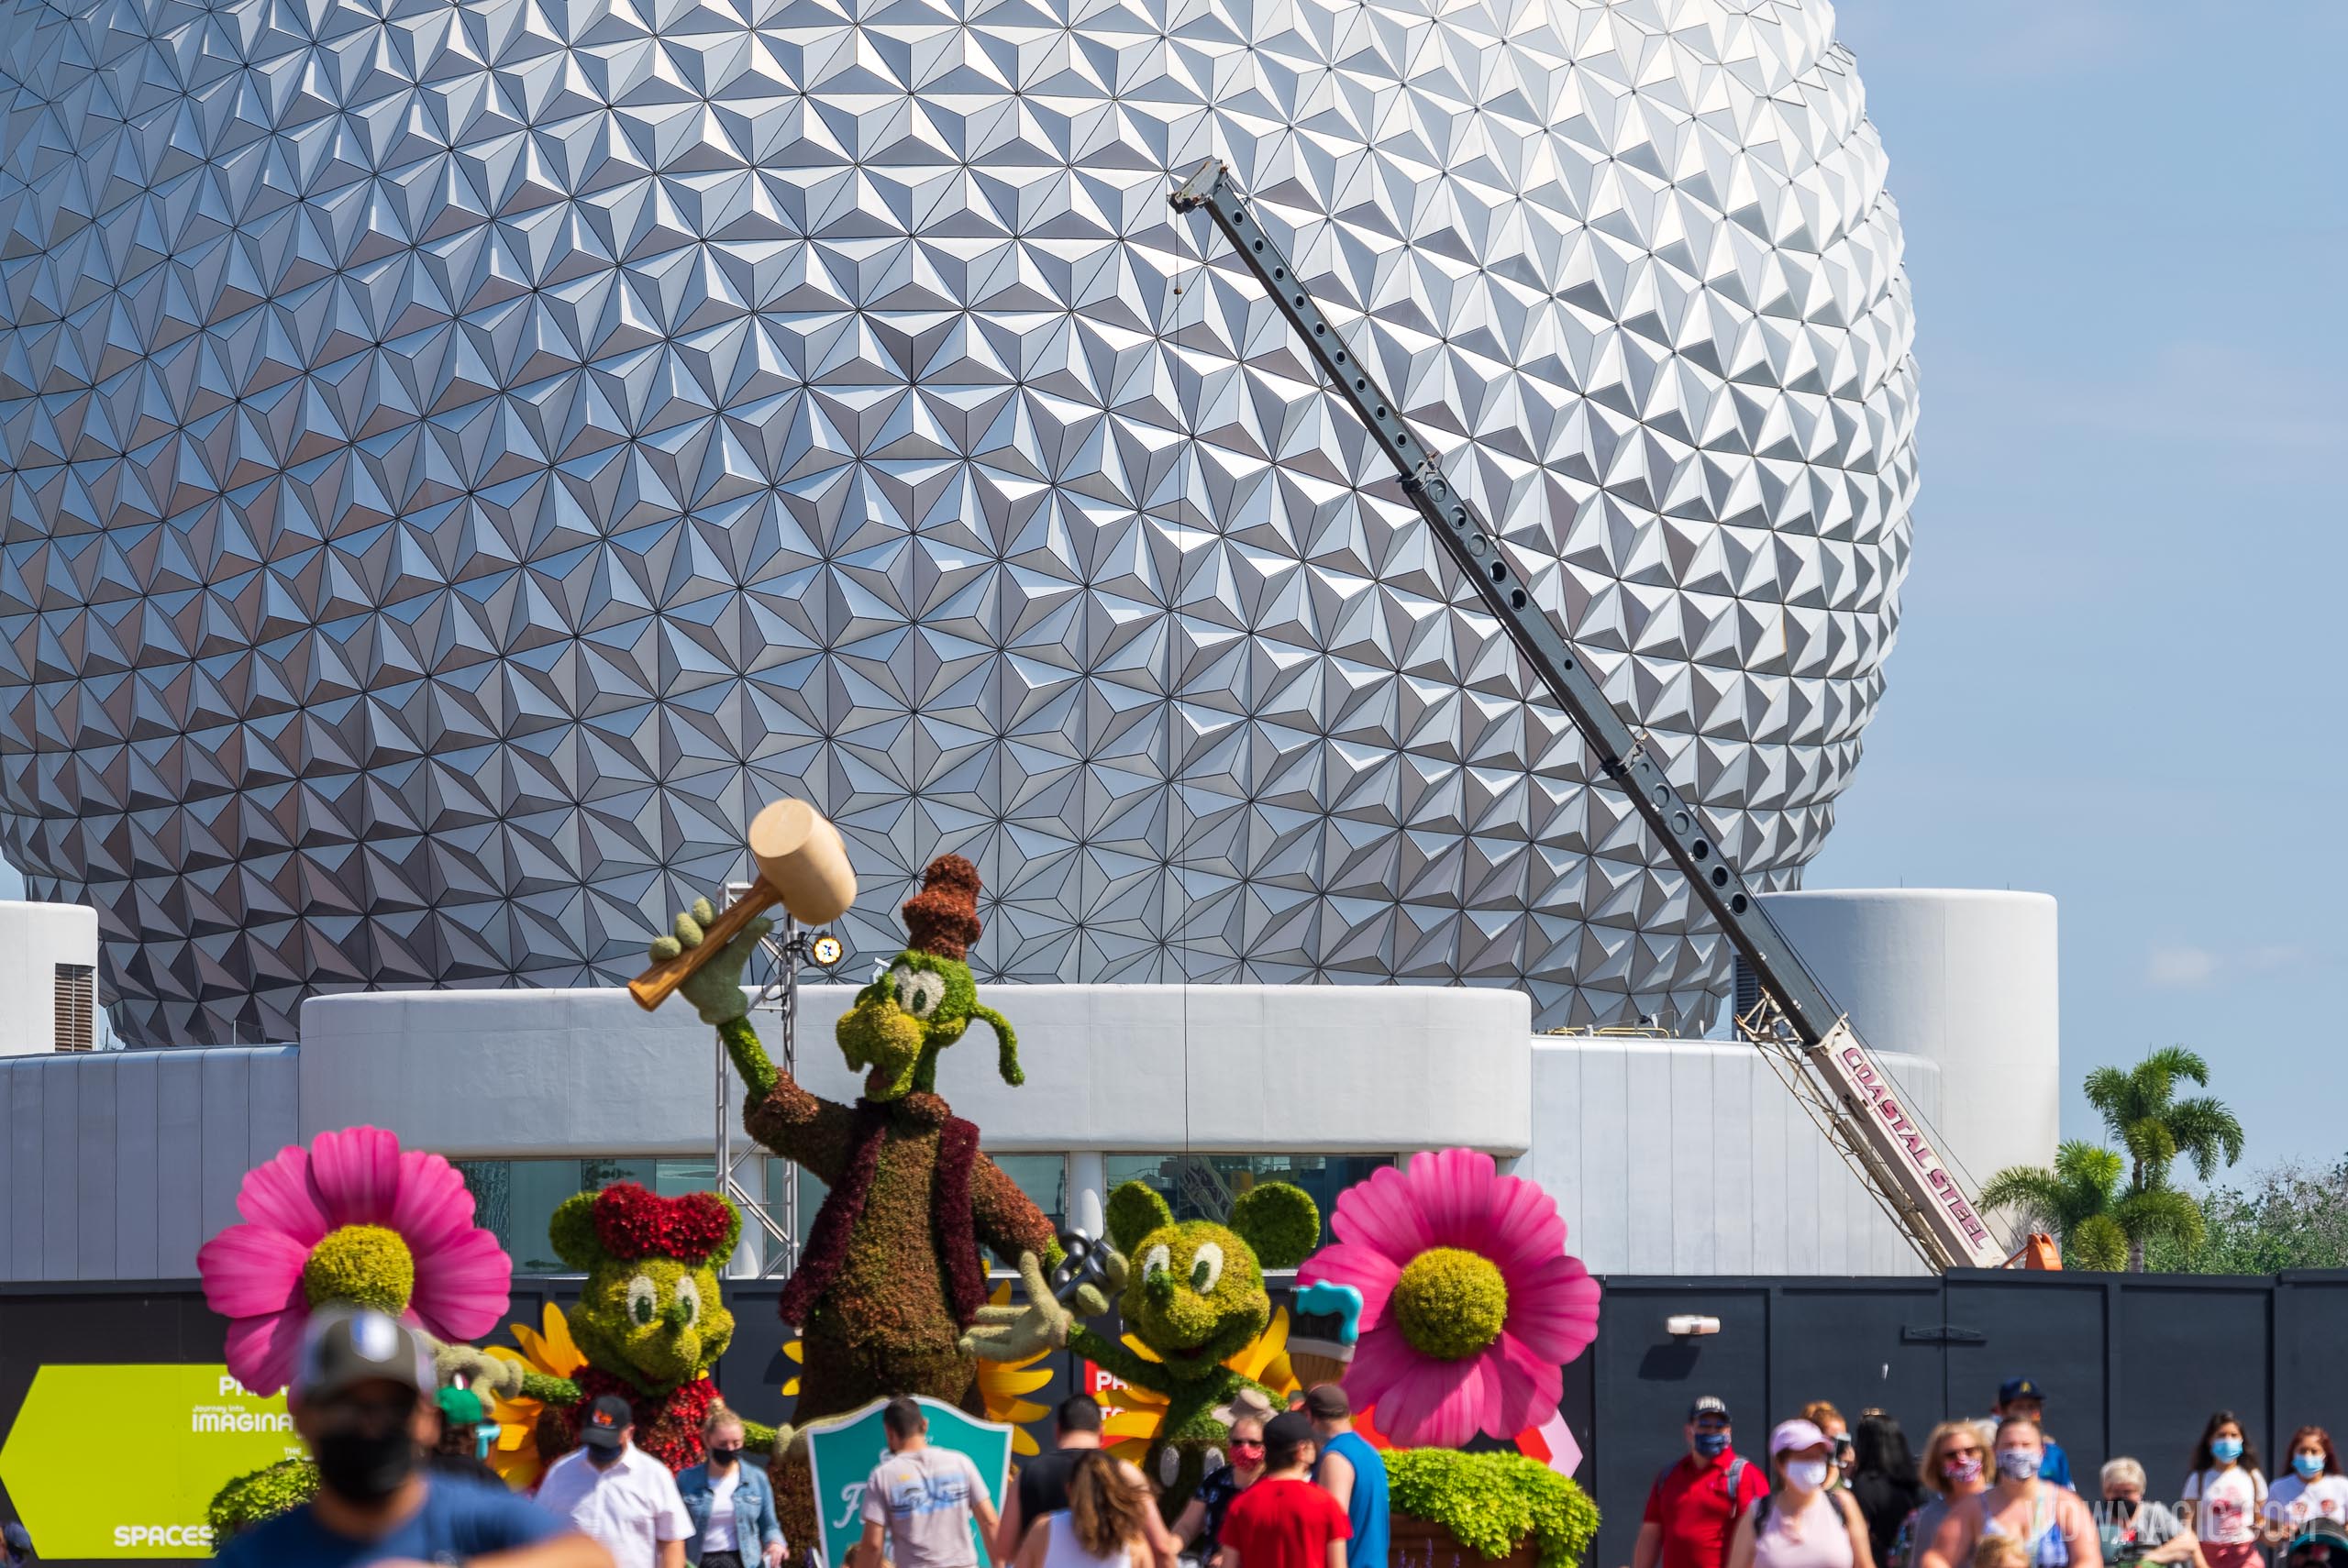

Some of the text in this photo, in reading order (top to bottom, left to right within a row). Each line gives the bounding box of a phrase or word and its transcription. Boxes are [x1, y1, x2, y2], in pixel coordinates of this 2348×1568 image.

[1843, 1047, 1988, 1250] COASTAL STEEL
[192, 1413, 293, 1432] IMAGINA
[284, 1447, 302, 1455] THE
[114, 1525, 216, 1547] SPACES
